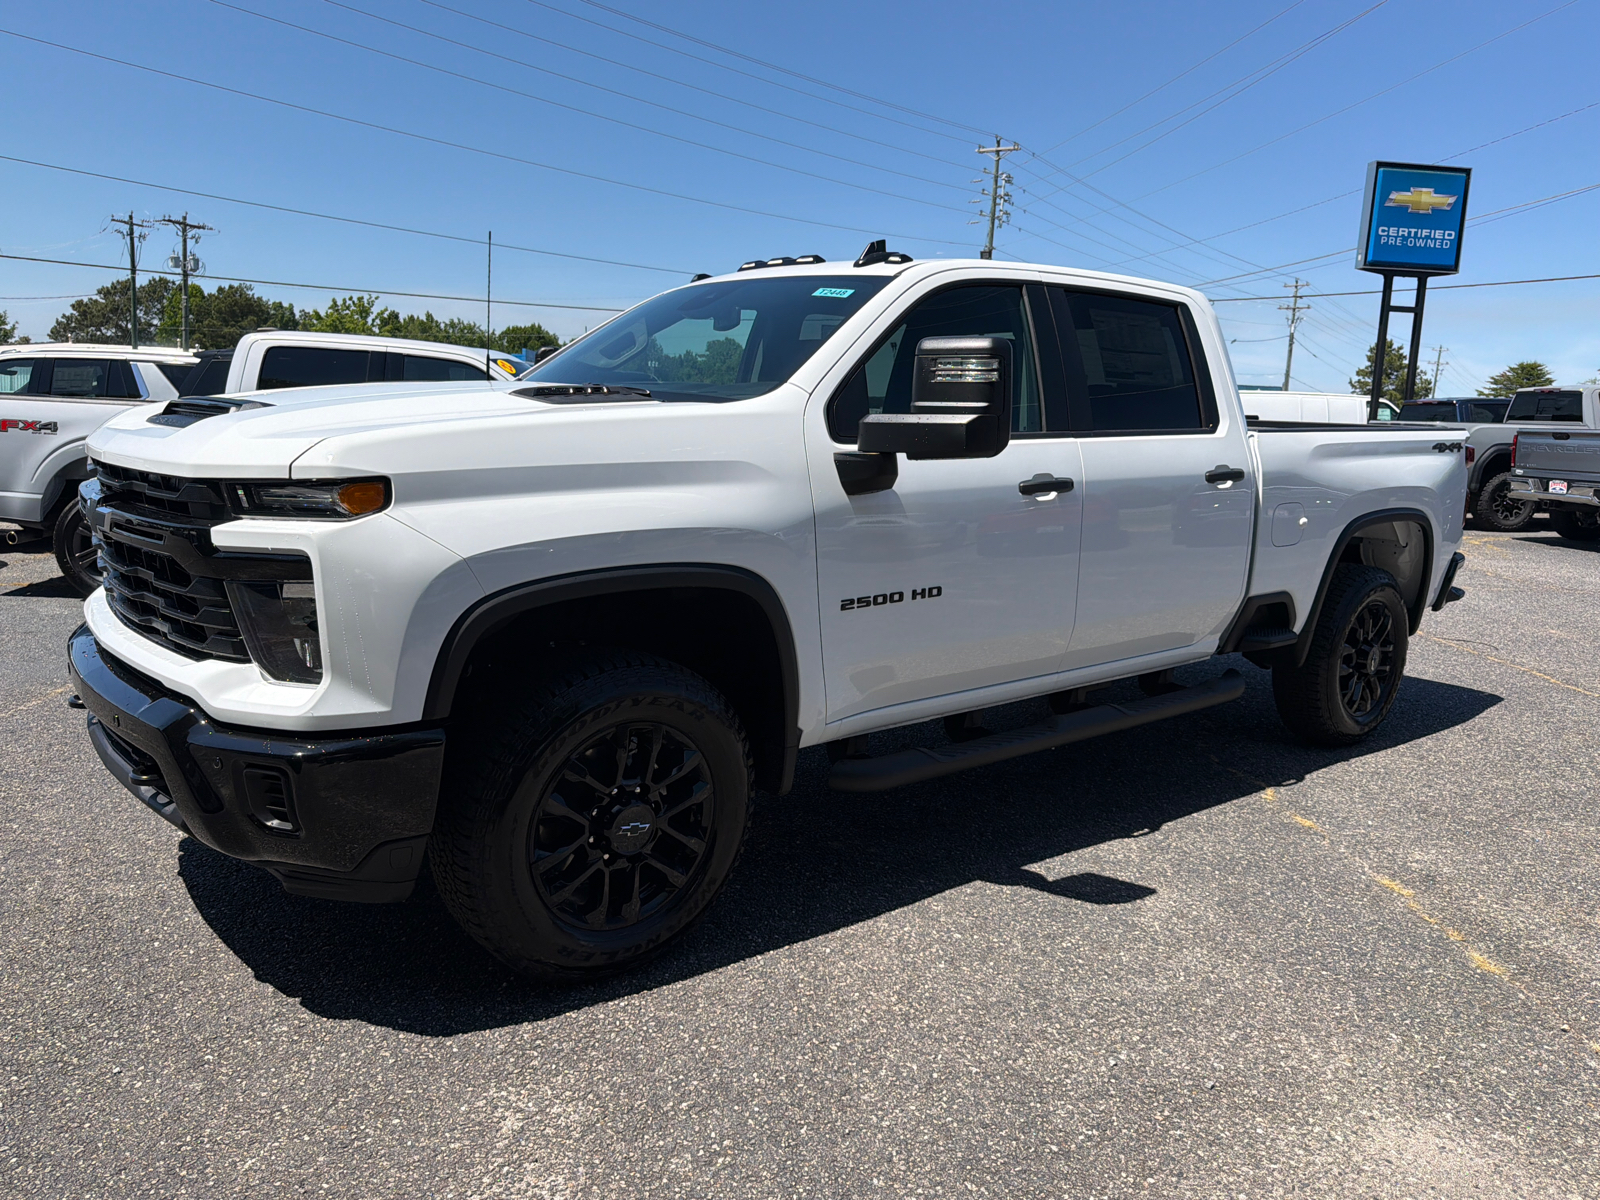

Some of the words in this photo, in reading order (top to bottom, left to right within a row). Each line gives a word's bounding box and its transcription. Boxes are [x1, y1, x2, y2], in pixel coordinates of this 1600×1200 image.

[1378, 226, 1455, 240] CERTIFIED
[1380, 236, 1451, 249] PRE-OWNED
[818, 288, 848, 296] T2448
[0, 418, 58, 432] FX4
[840, 591, 904, 611] 2500
[911, 586, 942, 600] HD
[531, 695, 706, 779] GOODYEAR
